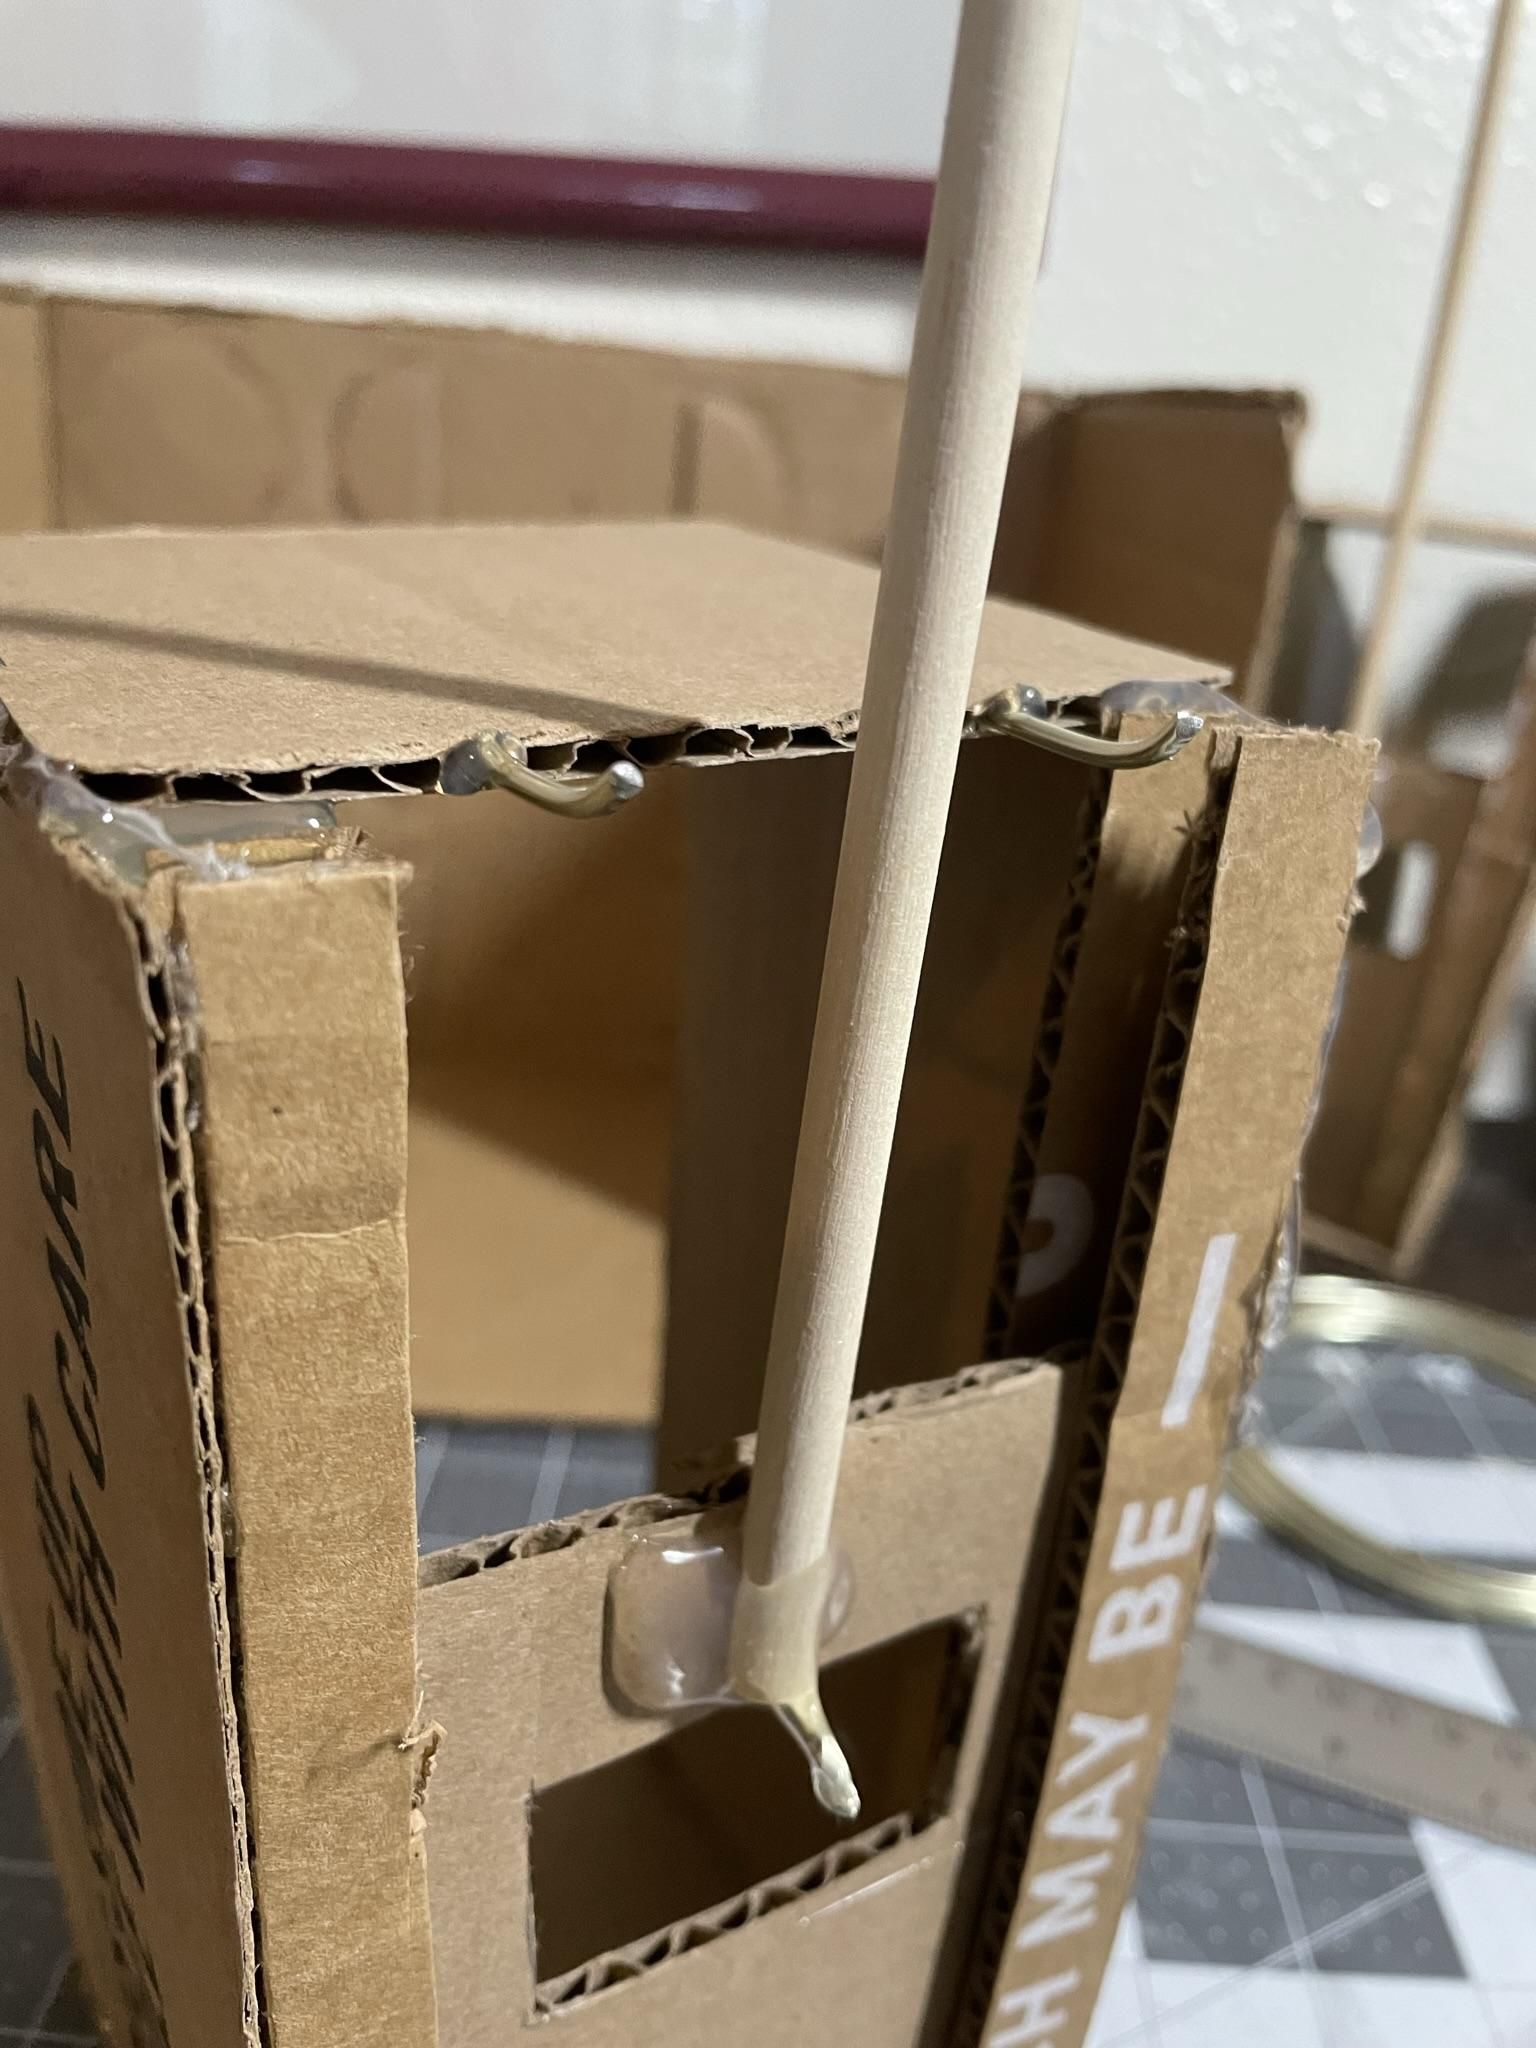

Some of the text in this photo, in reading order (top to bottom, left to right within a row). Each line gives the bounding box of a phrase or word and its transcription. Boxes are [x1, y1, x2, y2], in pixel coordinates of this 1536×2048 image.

[15, 973, 107, 1492] CARE
[69, 1468, 145, 1892] WITH
[1088, 1483, 1209, 1665] BE
[1014, 1709, 1151, 1951] MAY
[986, 1967, 1082, 2048] H
